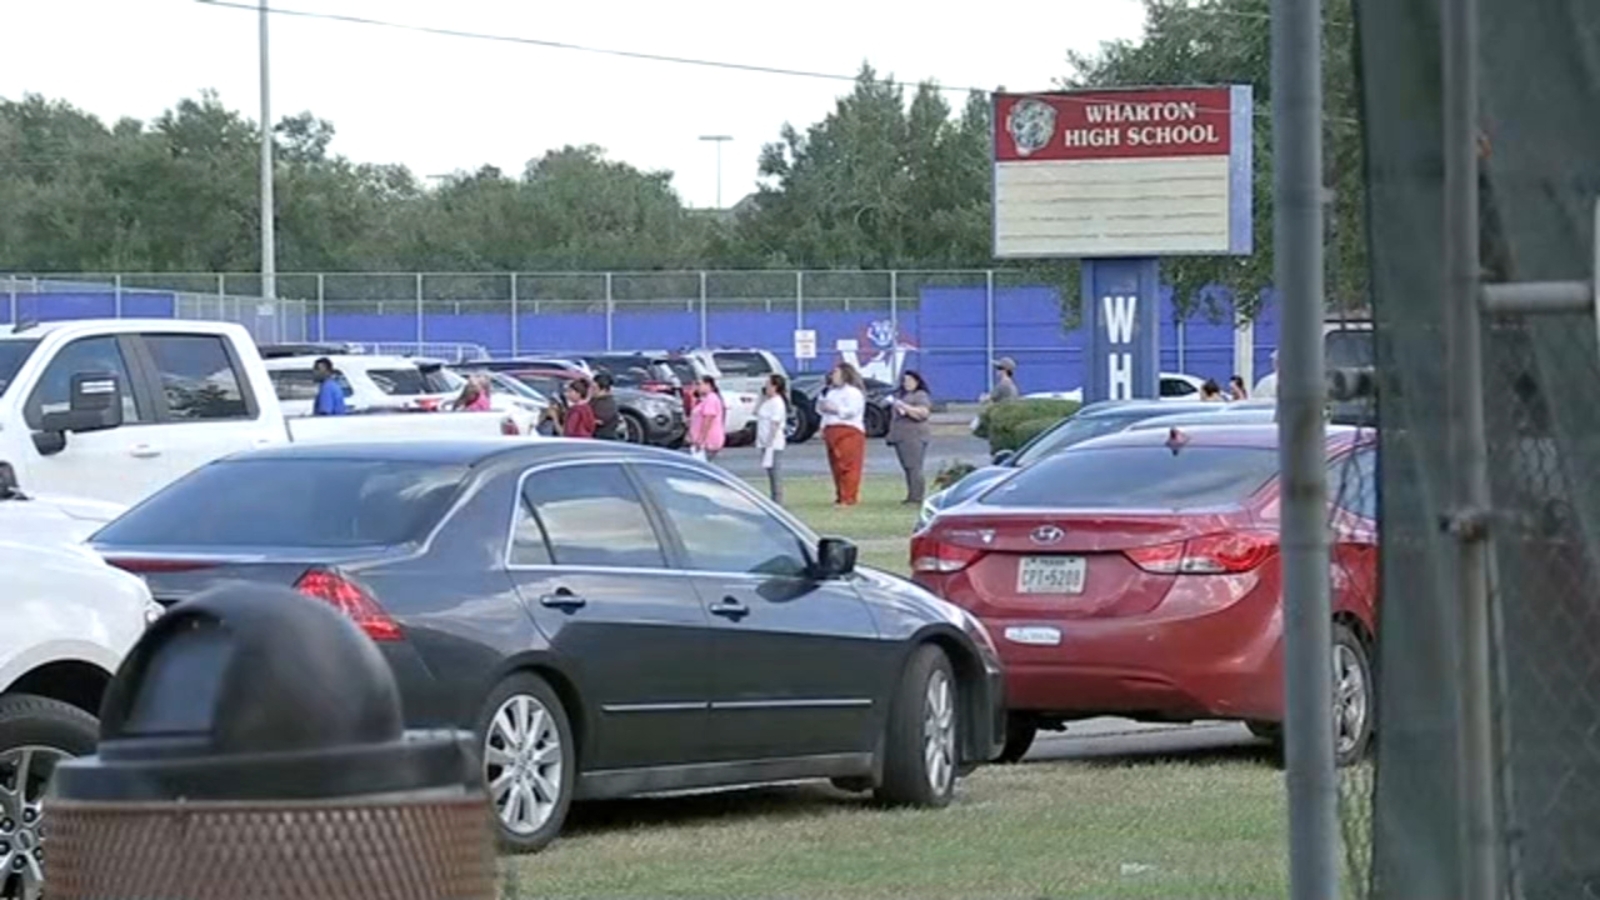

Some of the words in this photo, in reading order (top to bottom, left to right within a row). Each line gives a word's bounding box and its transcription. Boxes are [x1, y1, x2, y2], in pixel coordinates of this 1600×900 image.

[1085, 102, 1196, 123] WHARTON
[1065, 127, 1120, 147] HIGH
[1127, 124, 1219, 145] SCHOOL
